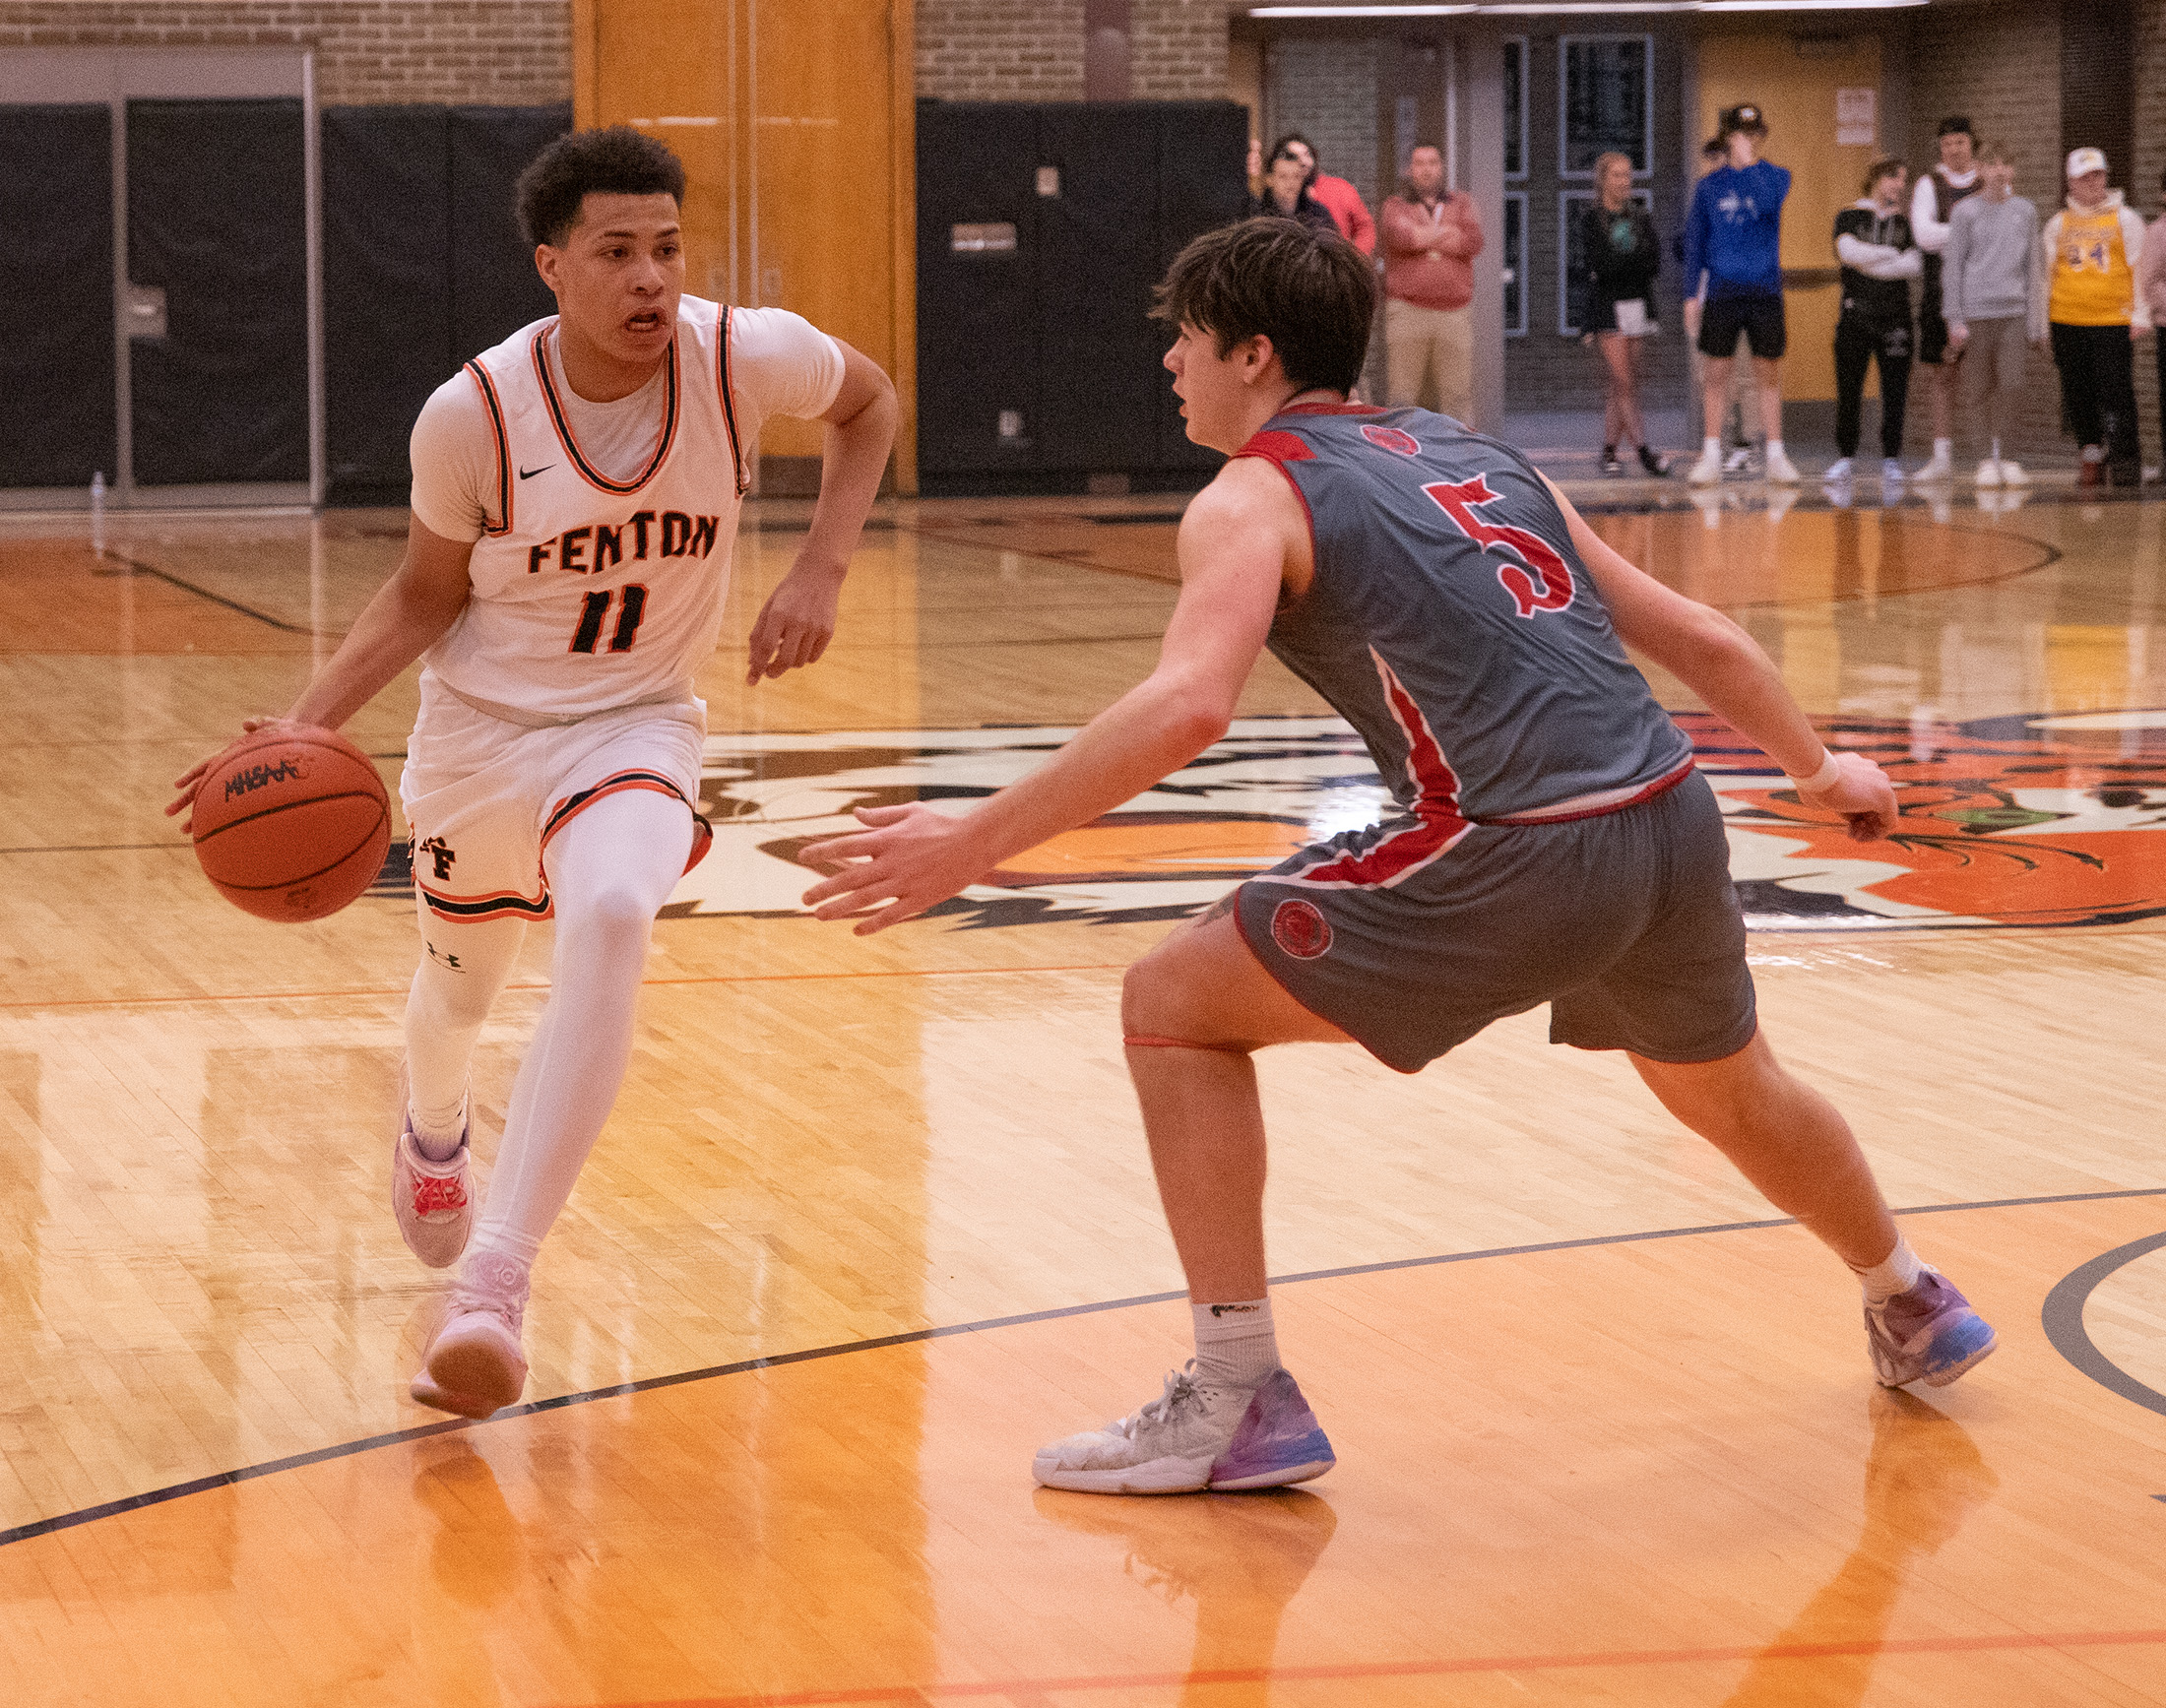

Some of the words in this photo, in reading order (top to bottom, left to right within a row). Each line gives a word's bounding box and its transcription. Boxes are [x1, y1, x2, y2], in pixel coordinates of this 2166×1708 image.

[528, 509, 722, 576] FENTON
[1420, 472, 1575, 620] 5
[568, 583, 651, 656] 11
[224, 759, 299, 803] MHSAA
